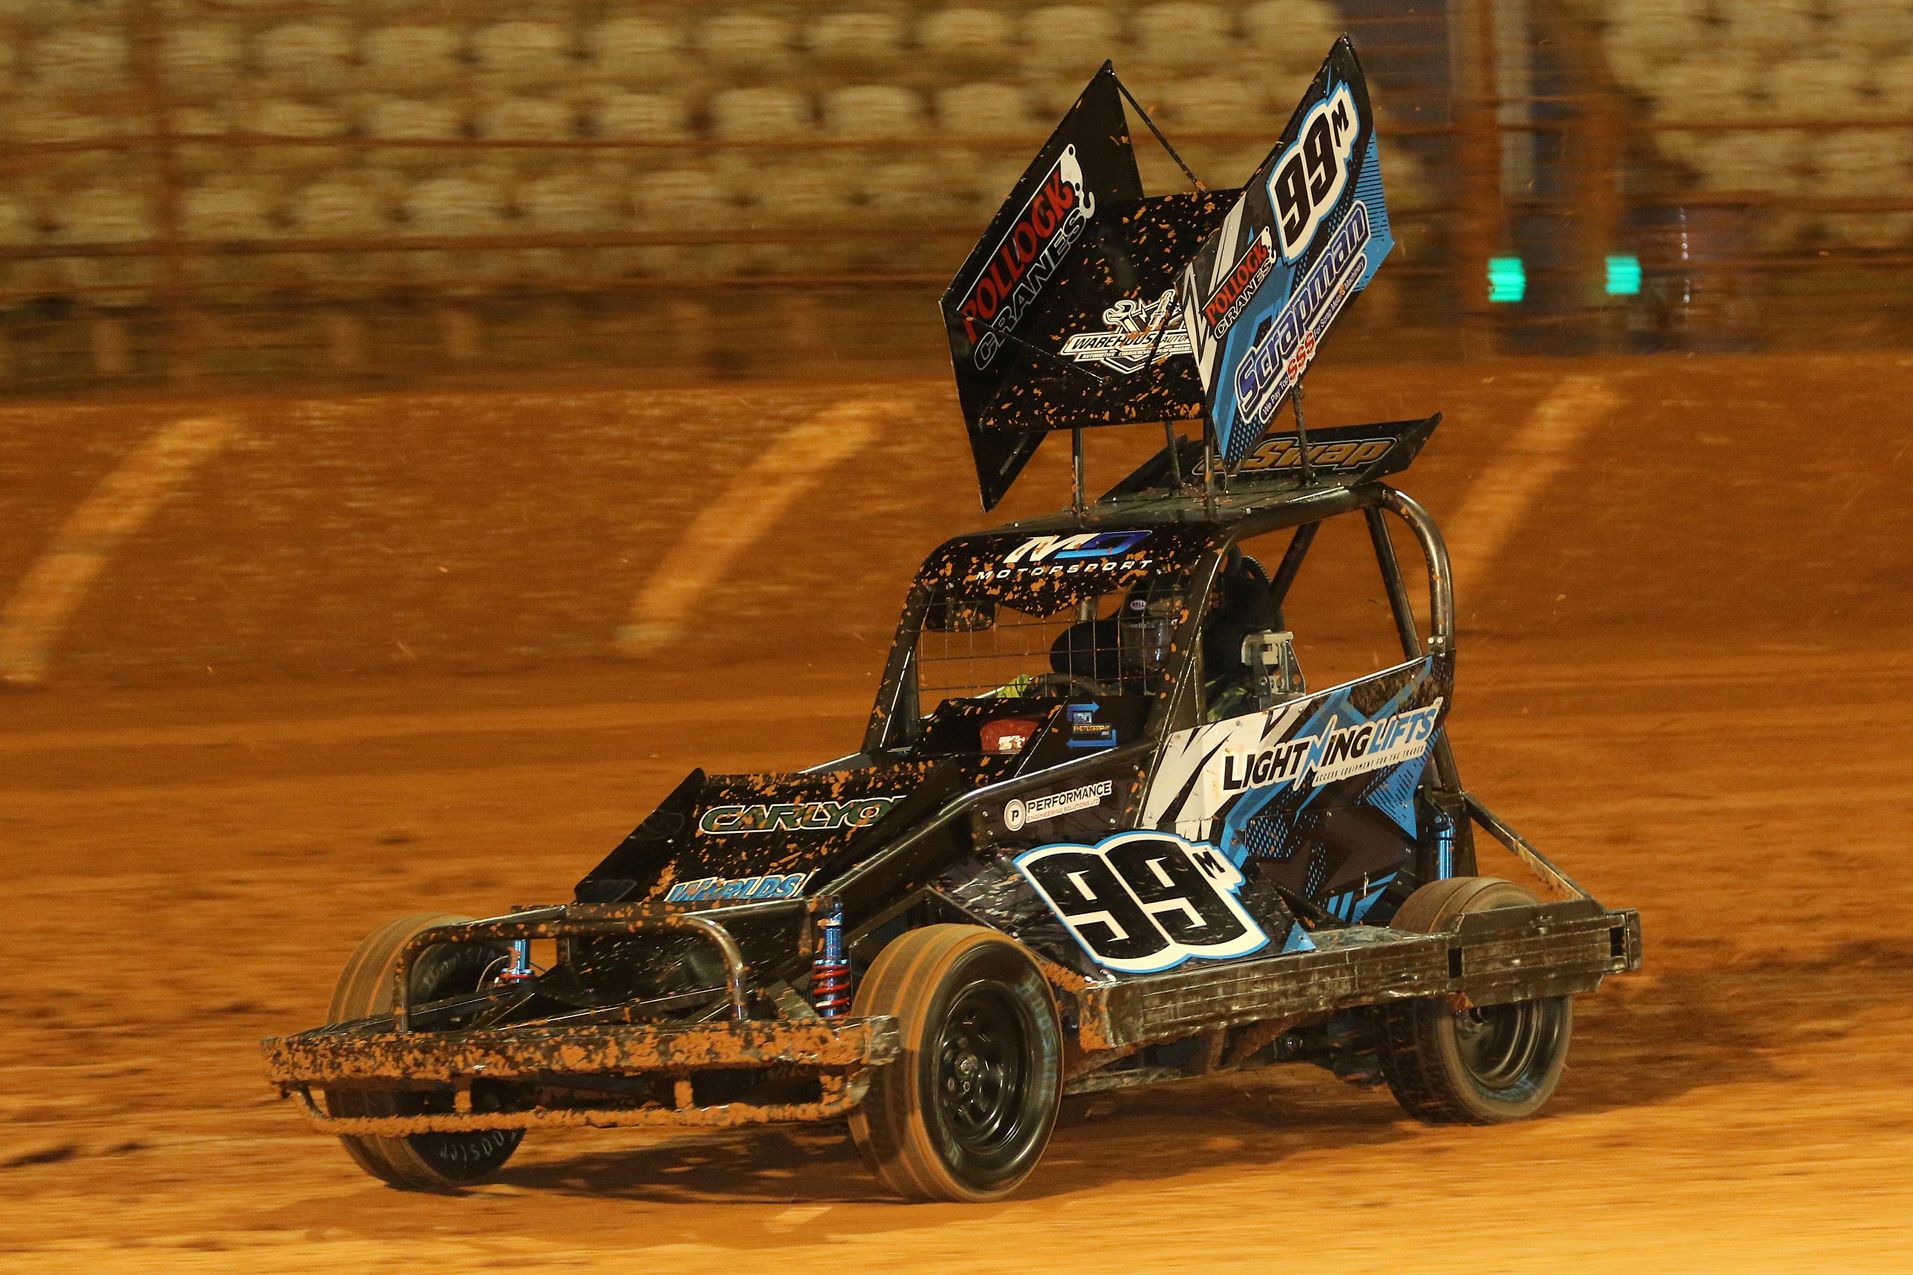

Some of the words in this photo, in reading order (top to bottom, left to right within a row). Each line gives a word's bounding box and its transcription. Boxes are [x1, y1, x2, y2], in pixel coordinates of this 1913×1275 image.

[962, 168, 1075, 345] POLLOCK
[974, 206, 1087, 371] CRANES
[1204, 238, 1269, 327] POLLOCK
[1214, 257, 1273, 340] CRANES
[1236, 204, 1367, 414] Scrapman
[1071, 331, 1159, 350] WAREHOUS
[1262, 402, 1272, 416] We
[1270, 388, 1281, 405] Pay
[1279, 376, 1289, 390] Top
[1247, 439, 1392, 469] Swap
[975, 559, 1153, 581] MOTORSPORT
[1315, 770, 1338, 783] ACCESS
[1340, 759, 1375, 776] EQUIPMENT
[1375, 756, 1388, 766] FOR
[1390, 751, 1401, 762] THE
[700, 796, 902, 834] CARLYO
[1027, 782, 1111, 813] PERFORMANCE
